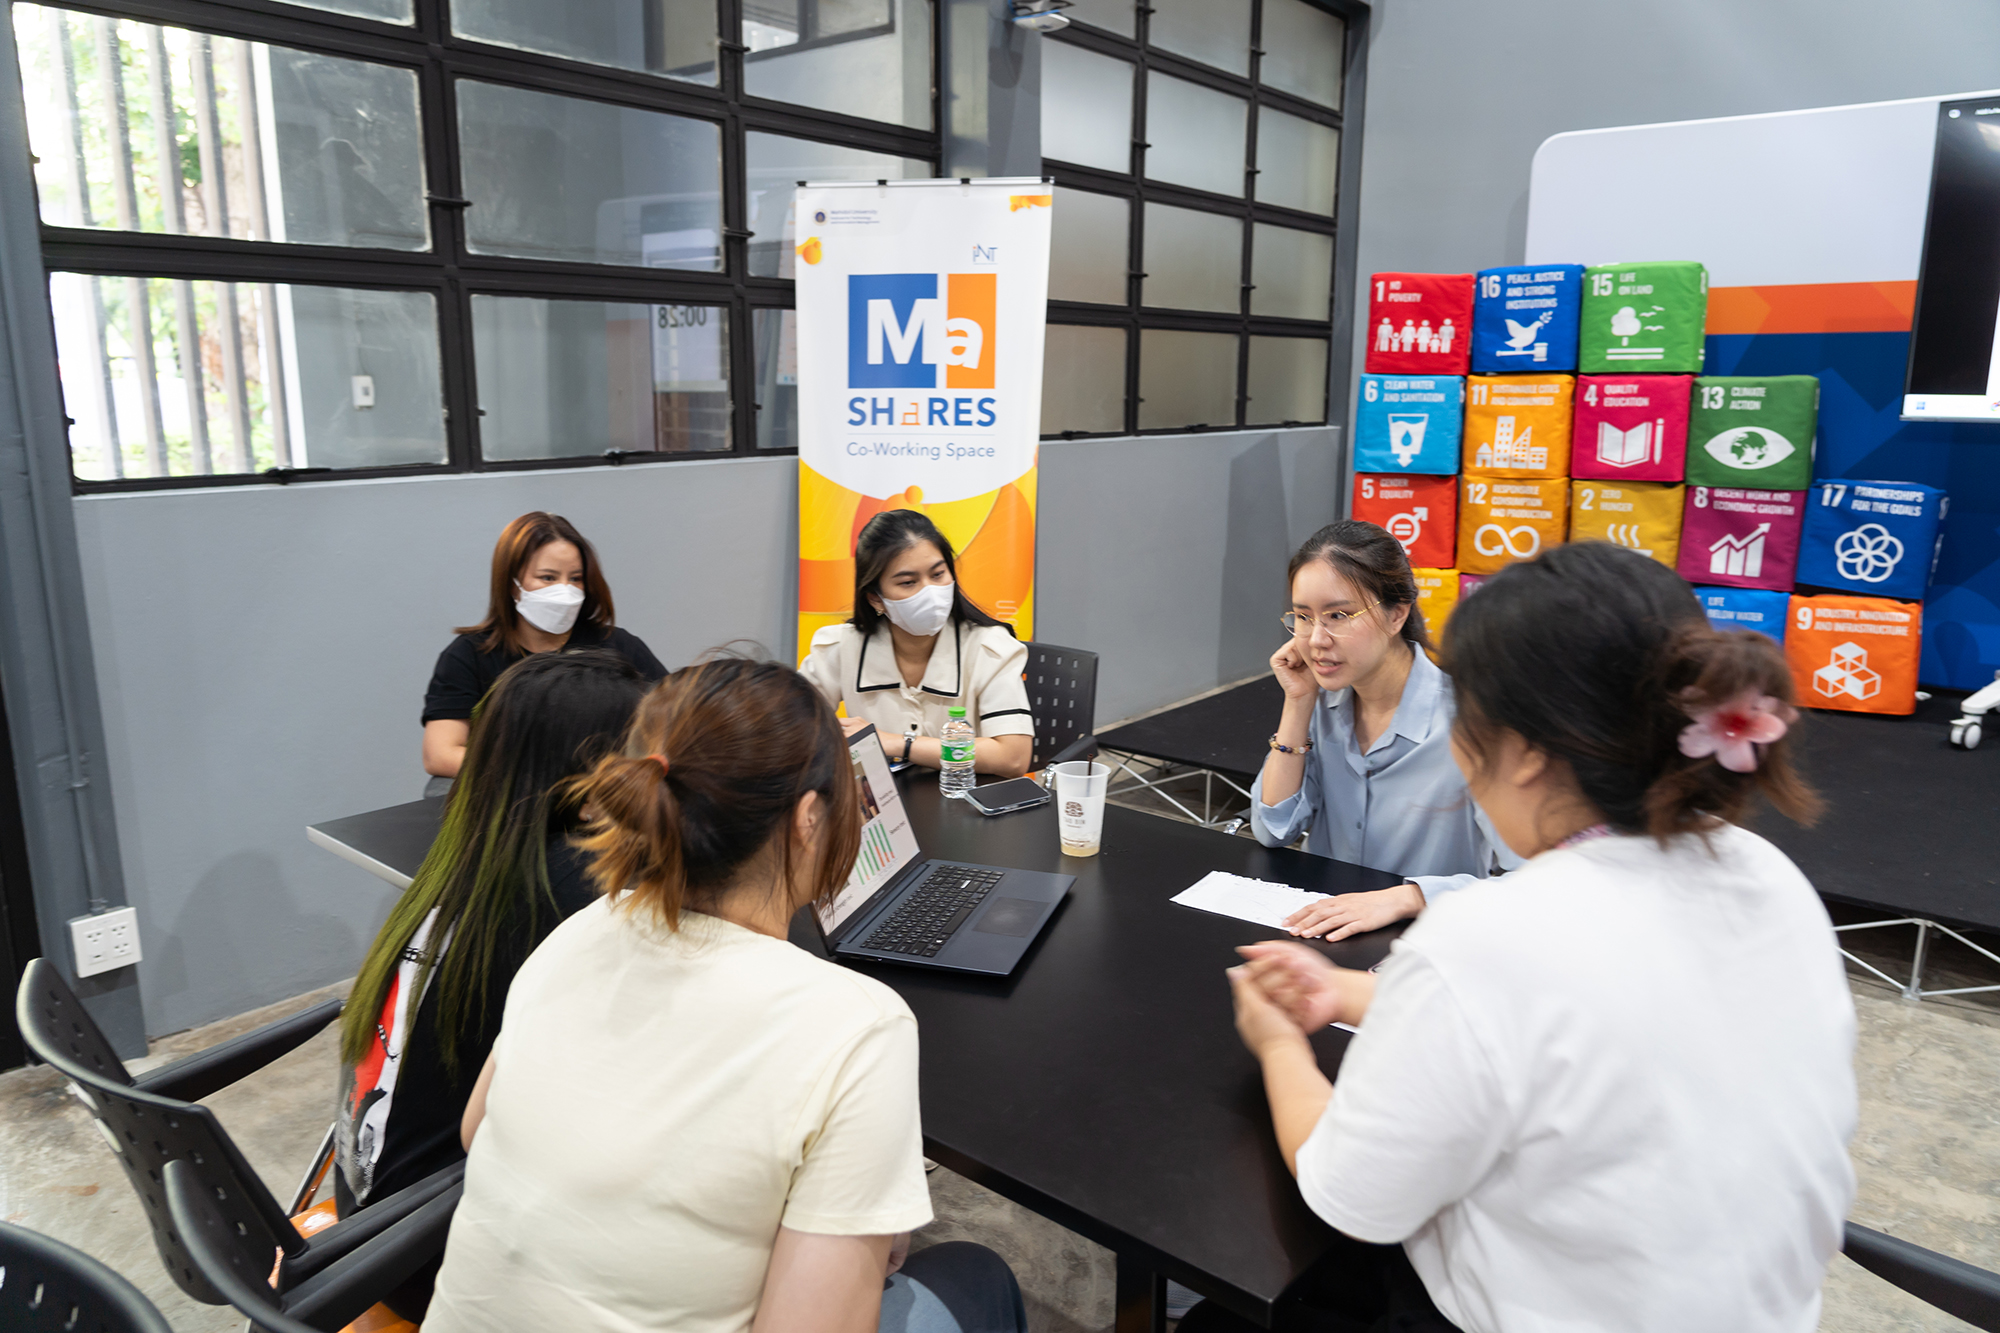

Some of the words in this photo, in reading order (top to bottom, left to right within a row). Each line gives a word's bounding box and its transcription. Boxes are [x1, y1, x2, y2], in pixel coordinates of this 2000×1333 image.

[1591, 273, 1613, 296] 15
[1619, 272, 1636, 282] LIFE
[1375, 281, 1385, 302] 1
[1480, 275, 1501, 298] 16
[1506, 287, 1524, 297] AND
[1524, 285, 1556, 296] STRONG
[1618, 286, 1631, 295] ON
[1632, 284, 1653, 295] LAND
[1388, 293, 1423, 302] POVERTY
[867, 298, 983, 370] Ma
[1364, 380, 1378, 402] 6
[1383, 380, 1408, 390] CLEAN
[1604, 384, 1639, 395] QUALITY
[1731, 387, 1767, 397] CLIMATE
[1383, 393, 1400, 402] AND
[1400, 393, 1445, 402] SANITATION
[1471, 384, 1488, 405] 11
[1584, 384, 1598, 407] 4
[1603, 397, 1650, 407] EDUCATION
[1701, 386, 1725, 410] 13
[1729, 400, 1761, 410] ACTION
[846, 441, 941, 460] Co-Working
[945, 442, 995, 460] Space
[1361, 478, 1374, 499] 5
[1379, 490, 1415, 499] EQUALITY
[1467, 483, 1488, 504] 12
[1600, 489, 1622, 499] ZERO
[1694, 486, 1709, 508] 8
[1821, 484, 1848, 507] 17
[1854, 485, 1925, 503] PARTNERSHIPS
[1580, 488, 1595, 510] 2
[1599, 502, 1634, 512] HUNGER
[1713, 500, 1756, 513] ECONOMIC
[1757, 503, 1795, 516] GROWTH
[1851, 499, 1870, 511] FOR
[1871, 502, 1889, 513] THE
[1889, 504, 1922, 517] GOALS
[1490, 508, 1505, 517] AND
[1796, 607, 1813, 630] 9
[1813, 621, 1833, 631] AND
